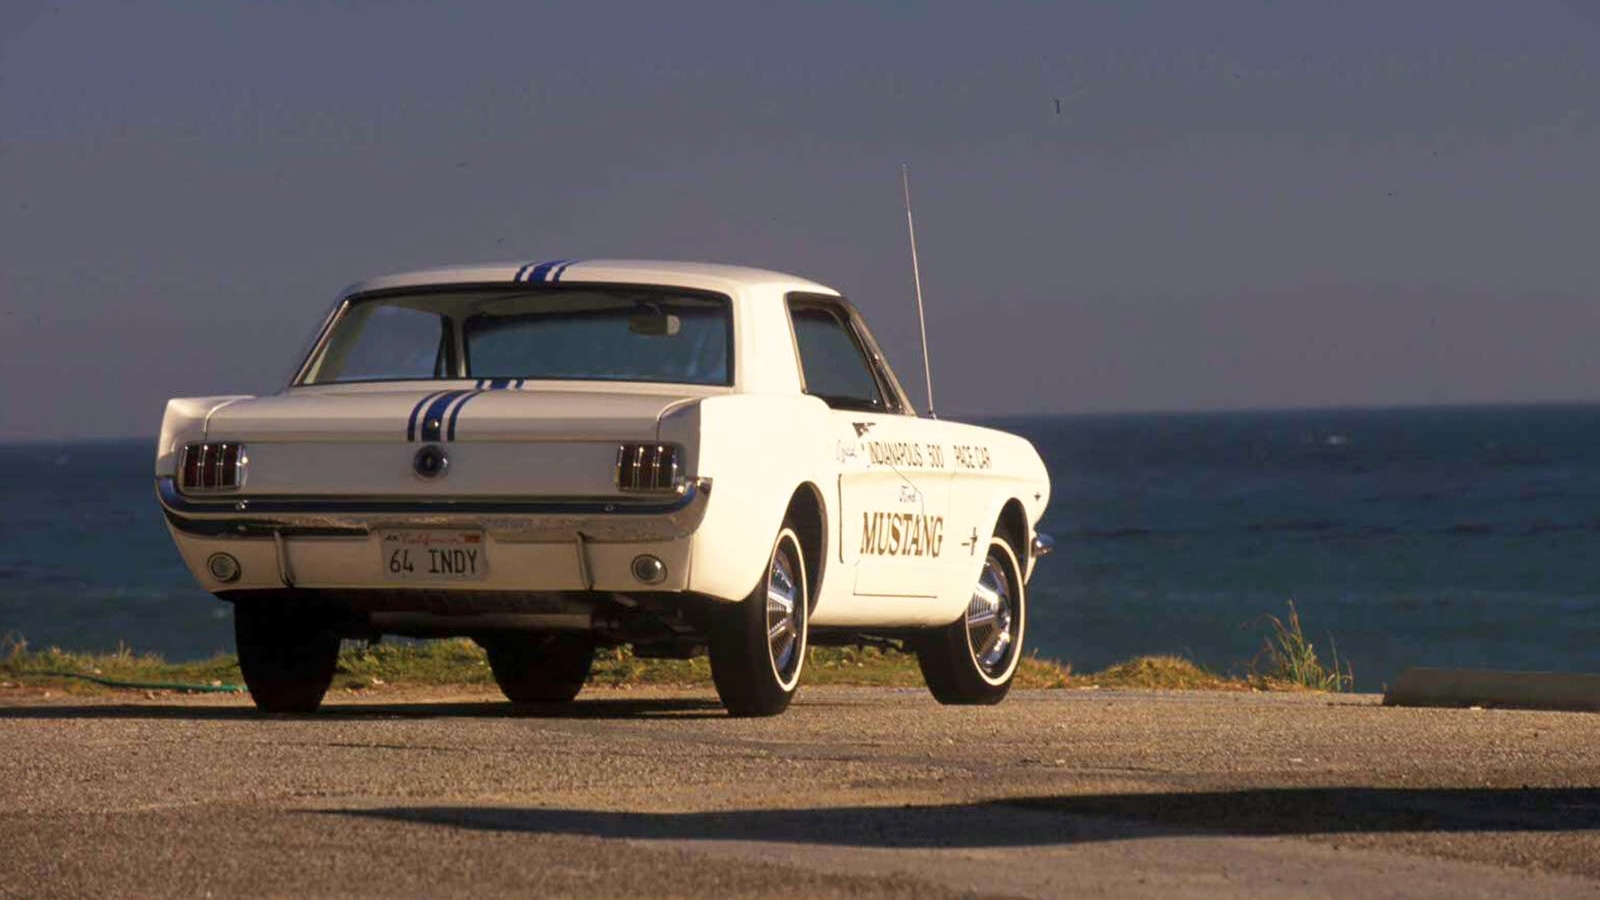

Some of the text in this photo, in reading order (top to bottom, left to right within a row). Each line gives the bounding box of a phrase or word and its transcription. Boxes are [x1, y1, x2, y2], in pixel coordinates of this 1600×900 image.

[868, 441, 923, 467] INDIANAPOLIS
[926, 444, 944, 468] 500
[953, 445, 975, 469] PACE
[975, 446, 992, 469] CAR
[860, 512, 943, 557] MUSTANG
[390, 549, 477, 574] 64 INDY
